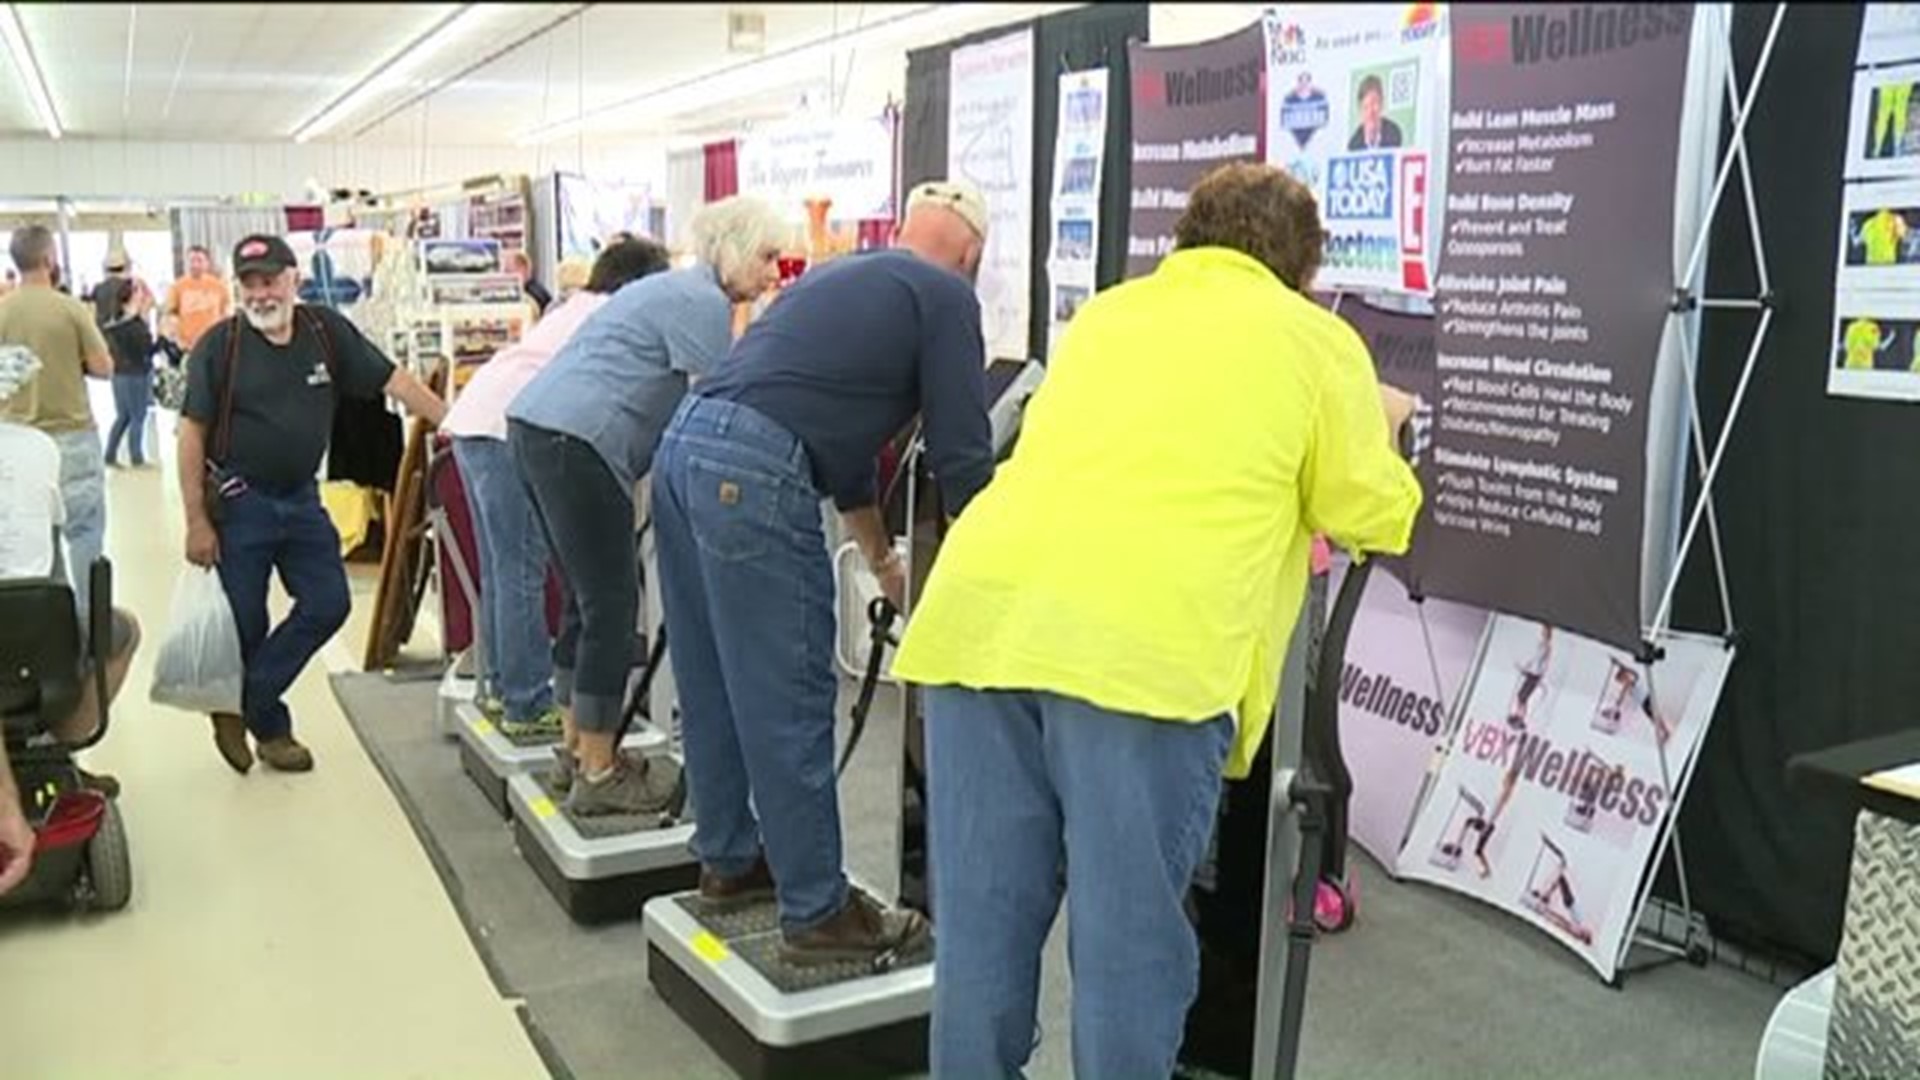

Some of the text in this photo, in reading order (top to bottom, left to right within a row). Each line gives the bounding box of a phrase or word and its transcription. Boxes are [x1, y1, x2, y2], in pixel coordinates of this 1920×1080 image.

[1511, 3, 1687, 65] Wellness
[1486, 109, 1518, 130] Lean
[1521, 104, 1572, 128] Muscle
[1575, 102, 1616, 122] Mass
[1349, 158, 1387, 187] USA
[1329, 187, 1387, 217] TODAY
[1518, 191, 1574, 214] Density
[1508, 218, 1532, 235] and
[1535, 216, 1568, 235] Treat
[1534, 275, 1567, 295] Pain
[1553, 301, 1582, 320] Pain
[1533, 357, 1612, 385] Circulation
[1511, 380, 1540, 400] Cells
[1599, 390, 1633, 416] Body
[1559, 406, 1611, 433] Treating
[1565, 466, 1619, 494] System
[1515, 482, 1543, 502] from
[1546, 485, 1566, 507] the
[1569, 491, 1602, 516] Body
[1342, 663, 1444, 738] Wellness
[1512, 729, 1664, 828] Wellness
